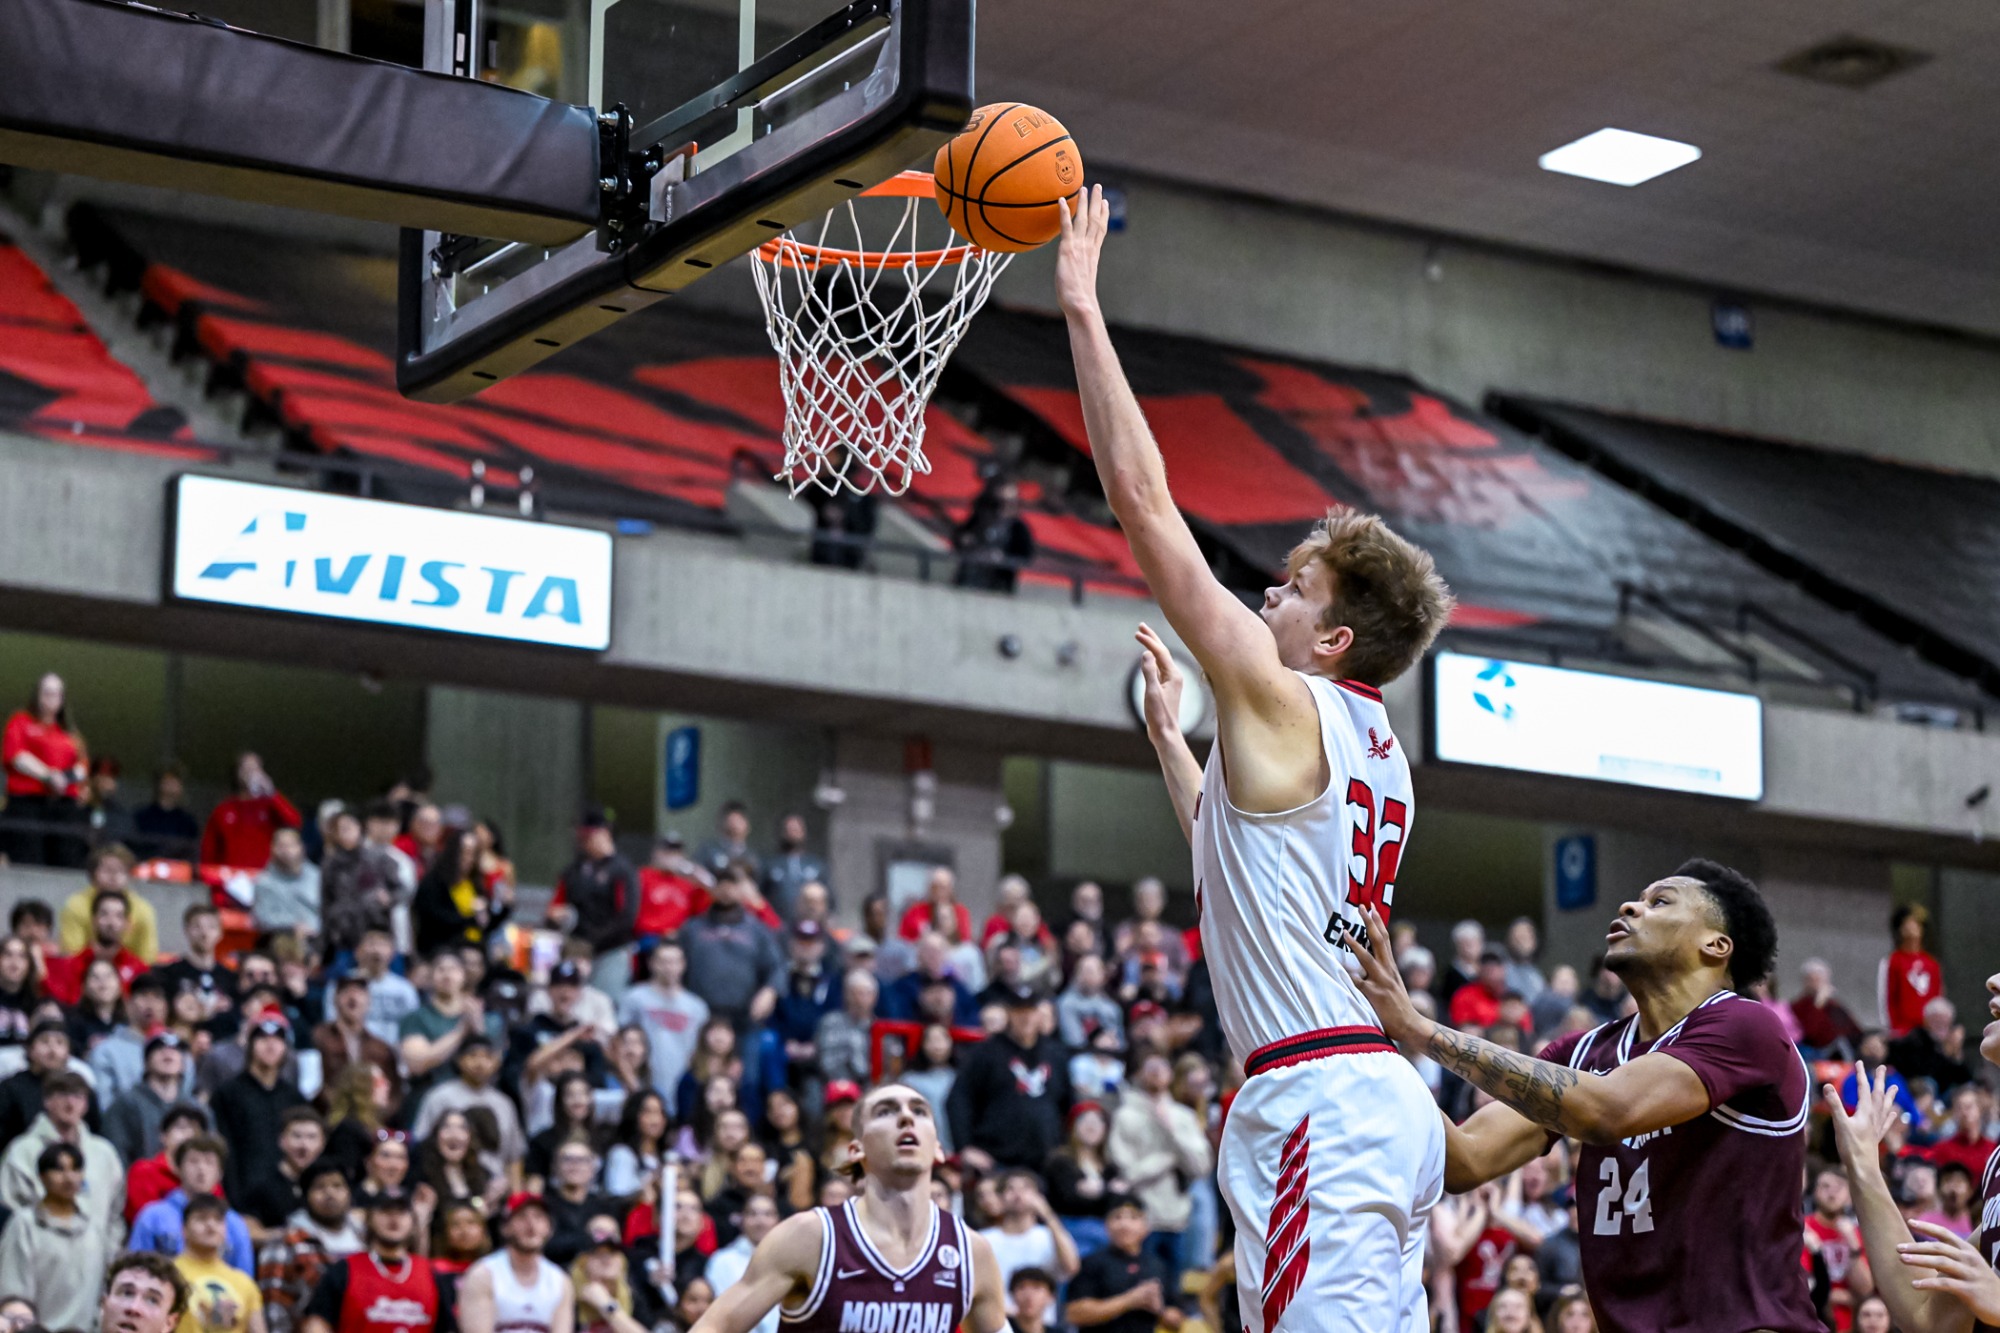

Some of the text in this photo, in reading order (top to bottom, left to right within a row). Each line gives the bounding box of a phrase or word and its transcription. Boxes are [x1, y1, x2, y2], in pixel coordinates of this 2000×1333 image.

[199, 511, 582, 625] AVISTA
[1346, 776, 1406, 928] 32
[1593, 1156, 1654, 1235] 24
[839, 1300, 953, 1333] MONTANA
